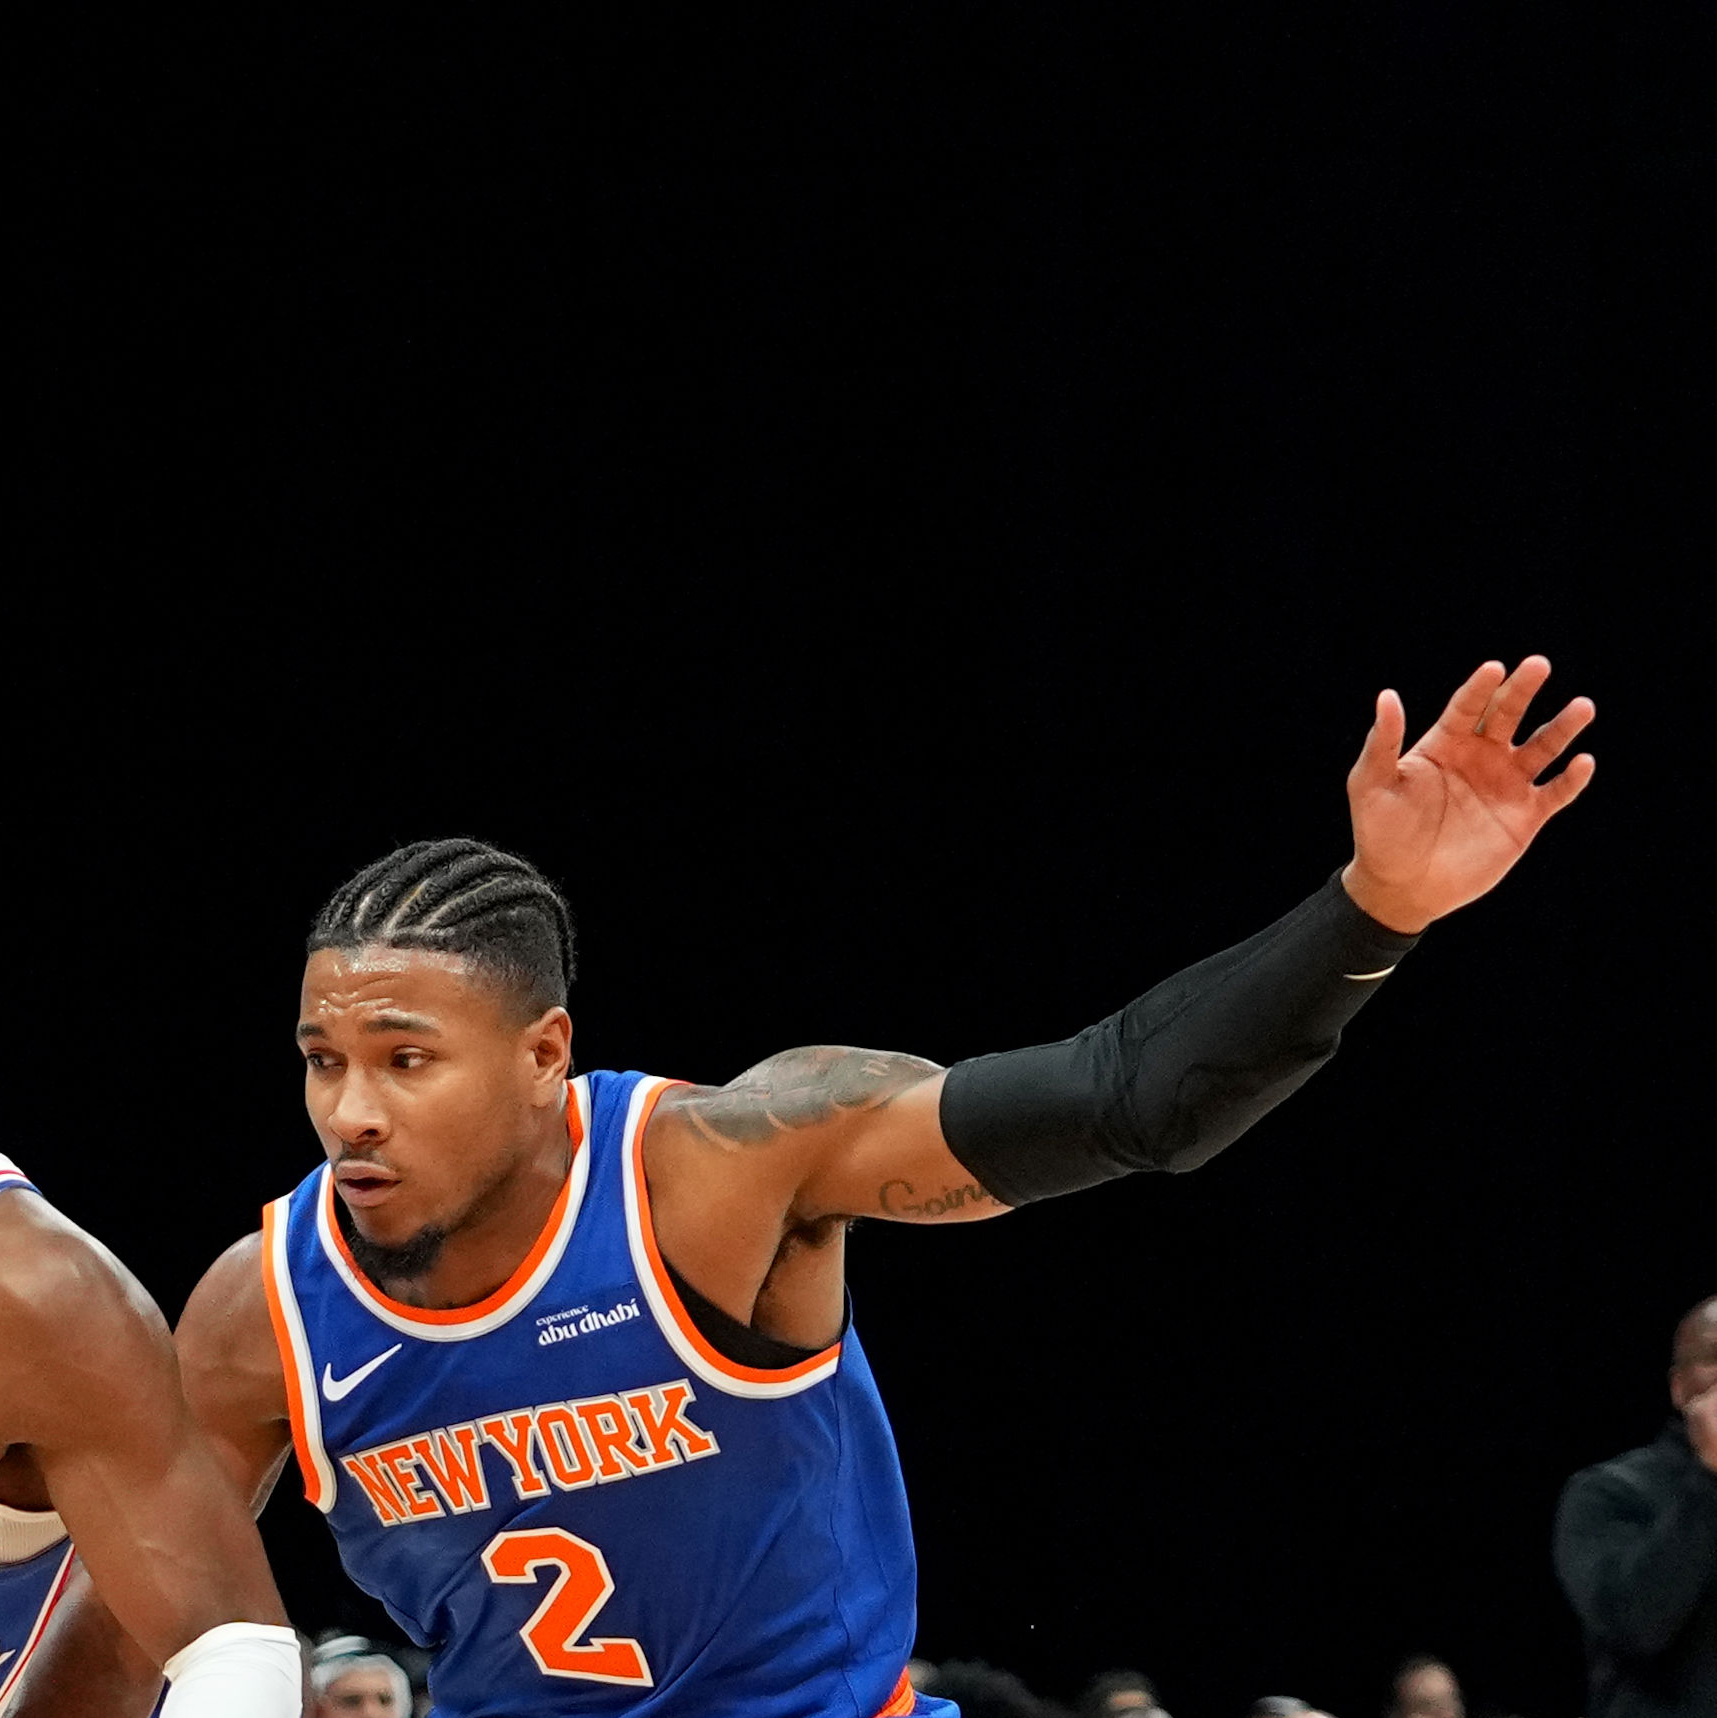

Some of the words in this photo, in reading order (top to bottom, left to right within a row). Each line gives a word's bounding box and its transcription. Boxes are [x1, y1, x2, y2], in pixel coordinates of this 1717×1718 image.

[538, 1323, 579, 1346] abu
[579, 1298, 641, 1334] dhabi
[341, 1421, 491, 1527] NEW
[482, 1378, 720, 1499] YORK
[481, 1526, 654, 1688] 2
